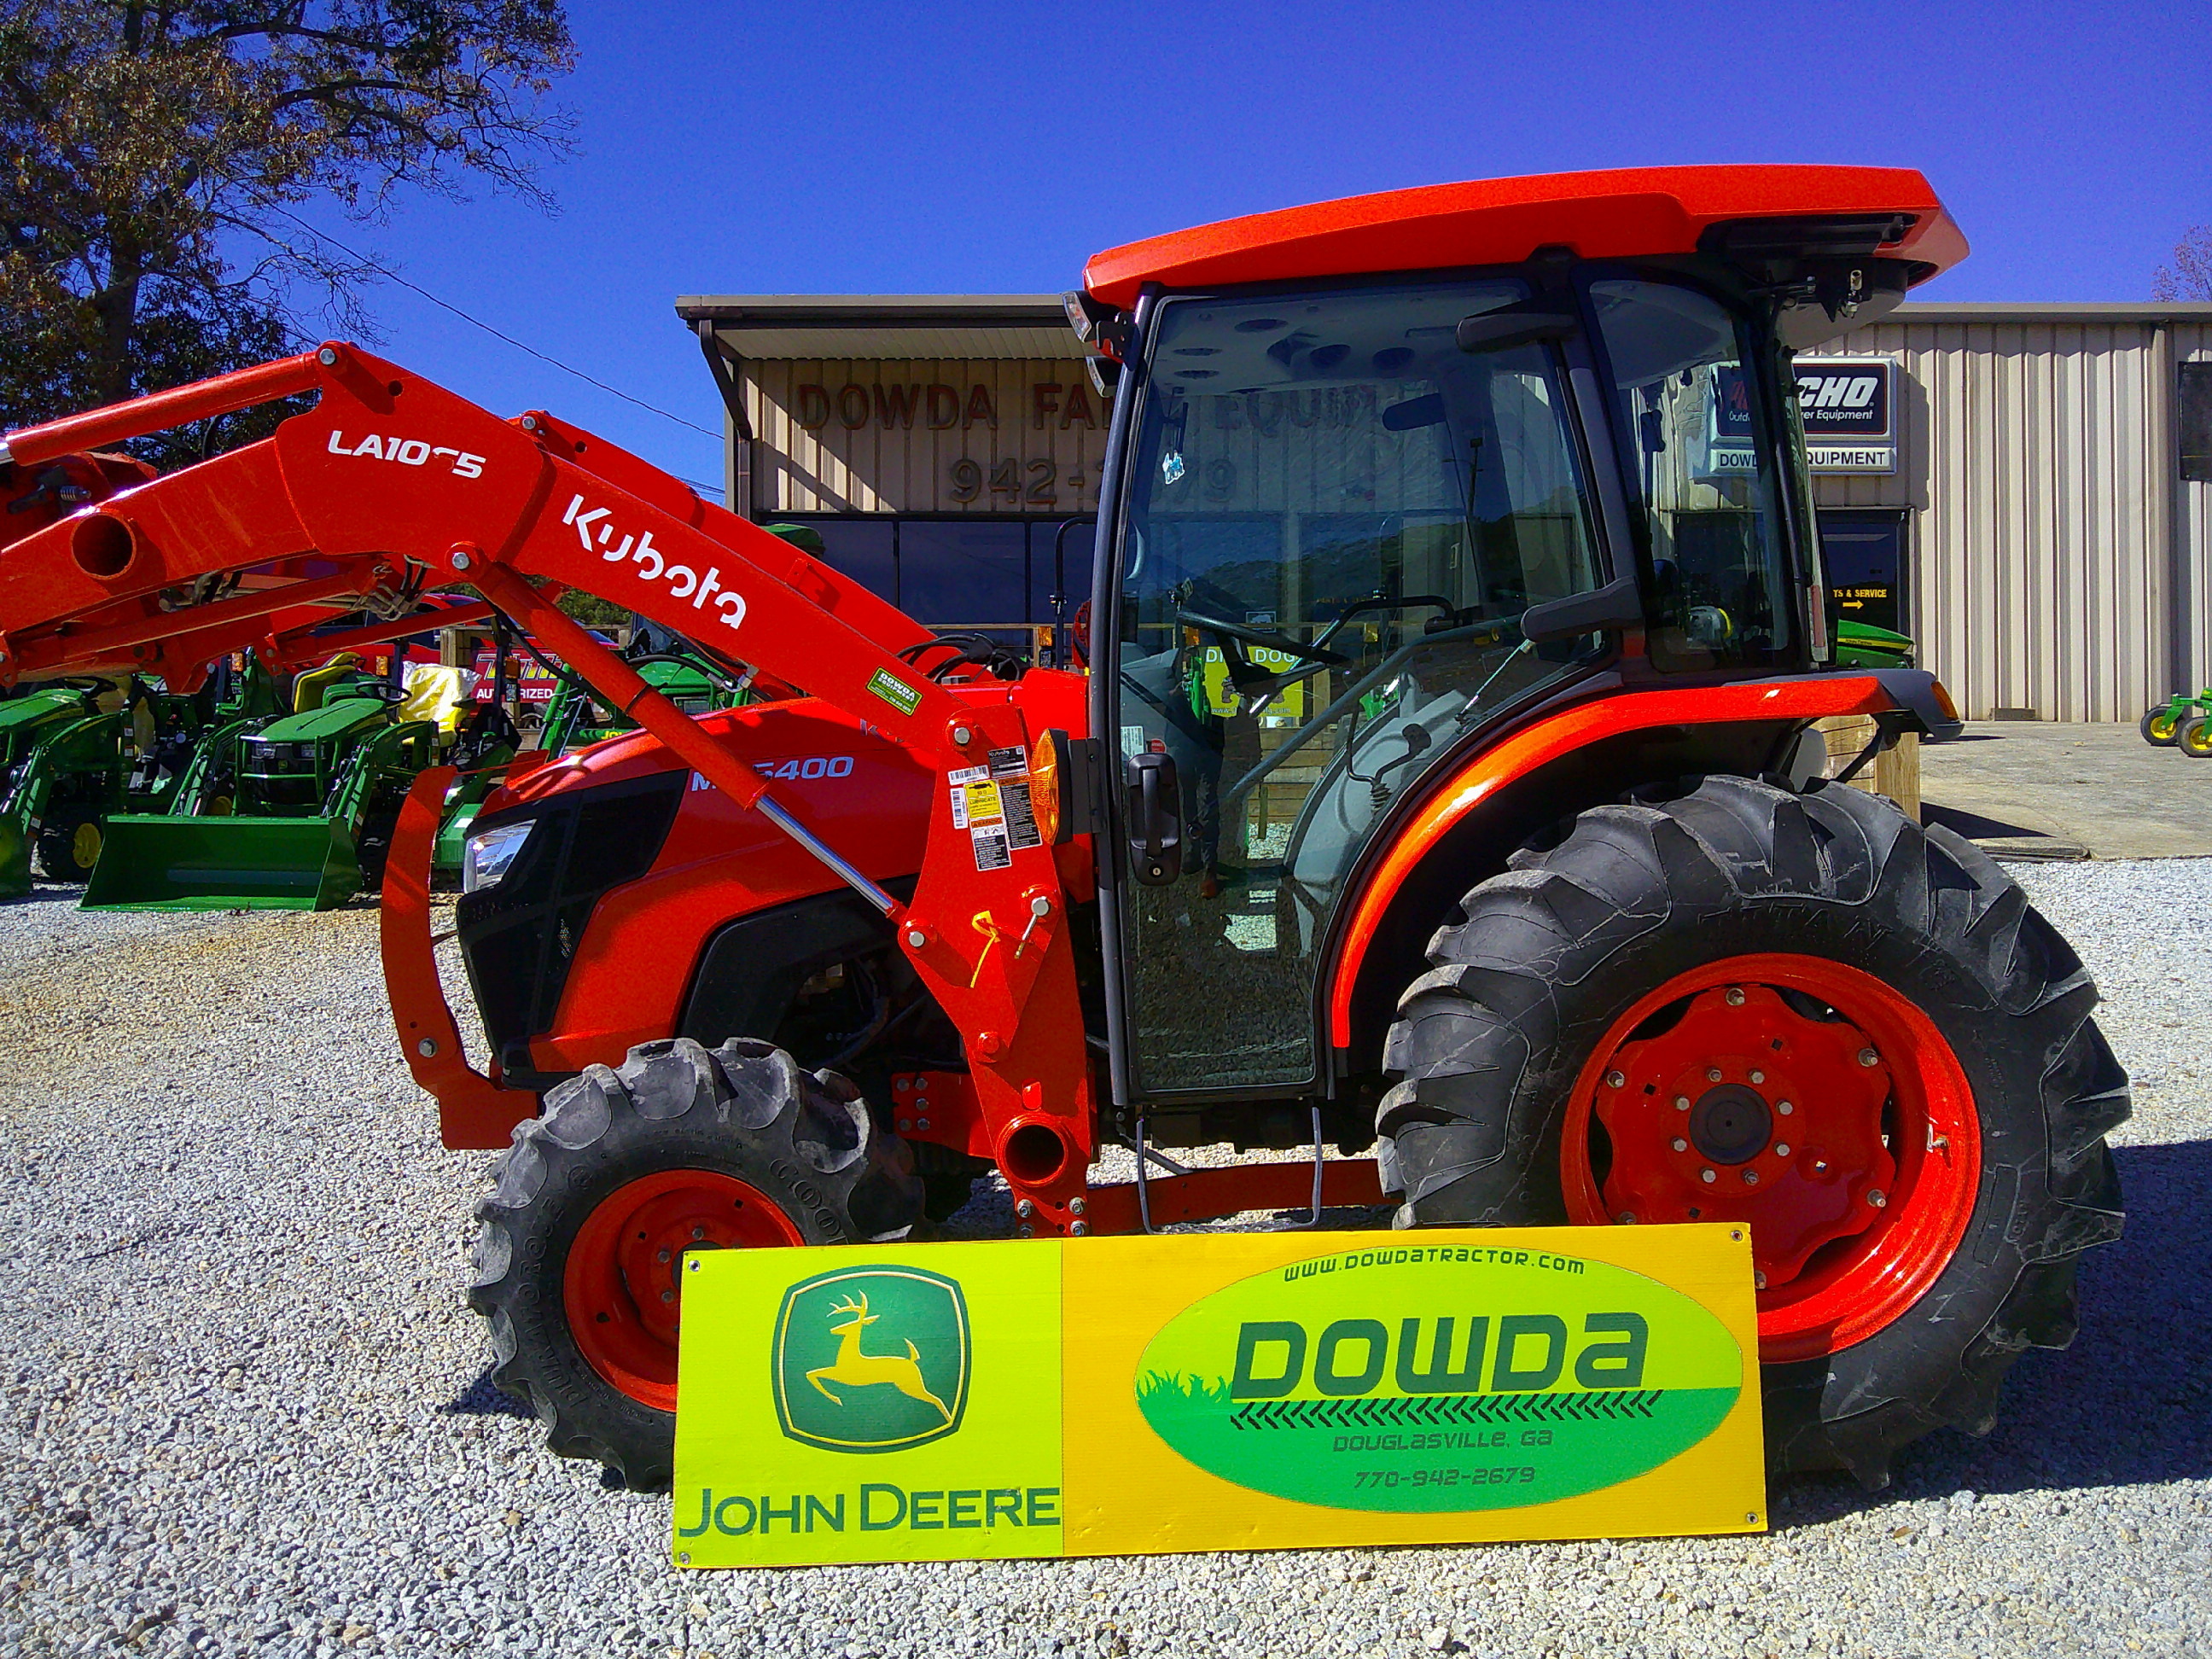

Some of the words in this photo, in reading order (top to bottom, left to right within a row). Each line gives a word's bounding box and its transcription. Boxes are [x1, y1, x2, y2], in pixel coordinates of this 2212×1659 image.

[1796, 376, 1878, 408] CHO
[796, 384, 998, 431] DOWDA
[1728, 410, 1753, 422] Outd
[1816, 409, 1874, 422] Equipment
[1720, 453, 1758, 468] DOW
[1807, 451, 1886, 466] QUIPMENT
[562, 493, 748, 631] Kubota
[1846, 589, 1852, 598] &
[1854, 589, 1888, 598] SERVICE
[476, 688, 553, 699] AURIZED
[880, 672, 916, 699] DOWDA
[691, 756, 854, 792] M5400
[1229, 1312, 1650, 1400] DOWDA
[1520, 1429, 1553, 1447] GA
[1354, 1466, 1536, 1488] 770-942-2679
[678, 1487, 846, 1539] JOHN
[859, 1482, 1062, 1532] DEERE
